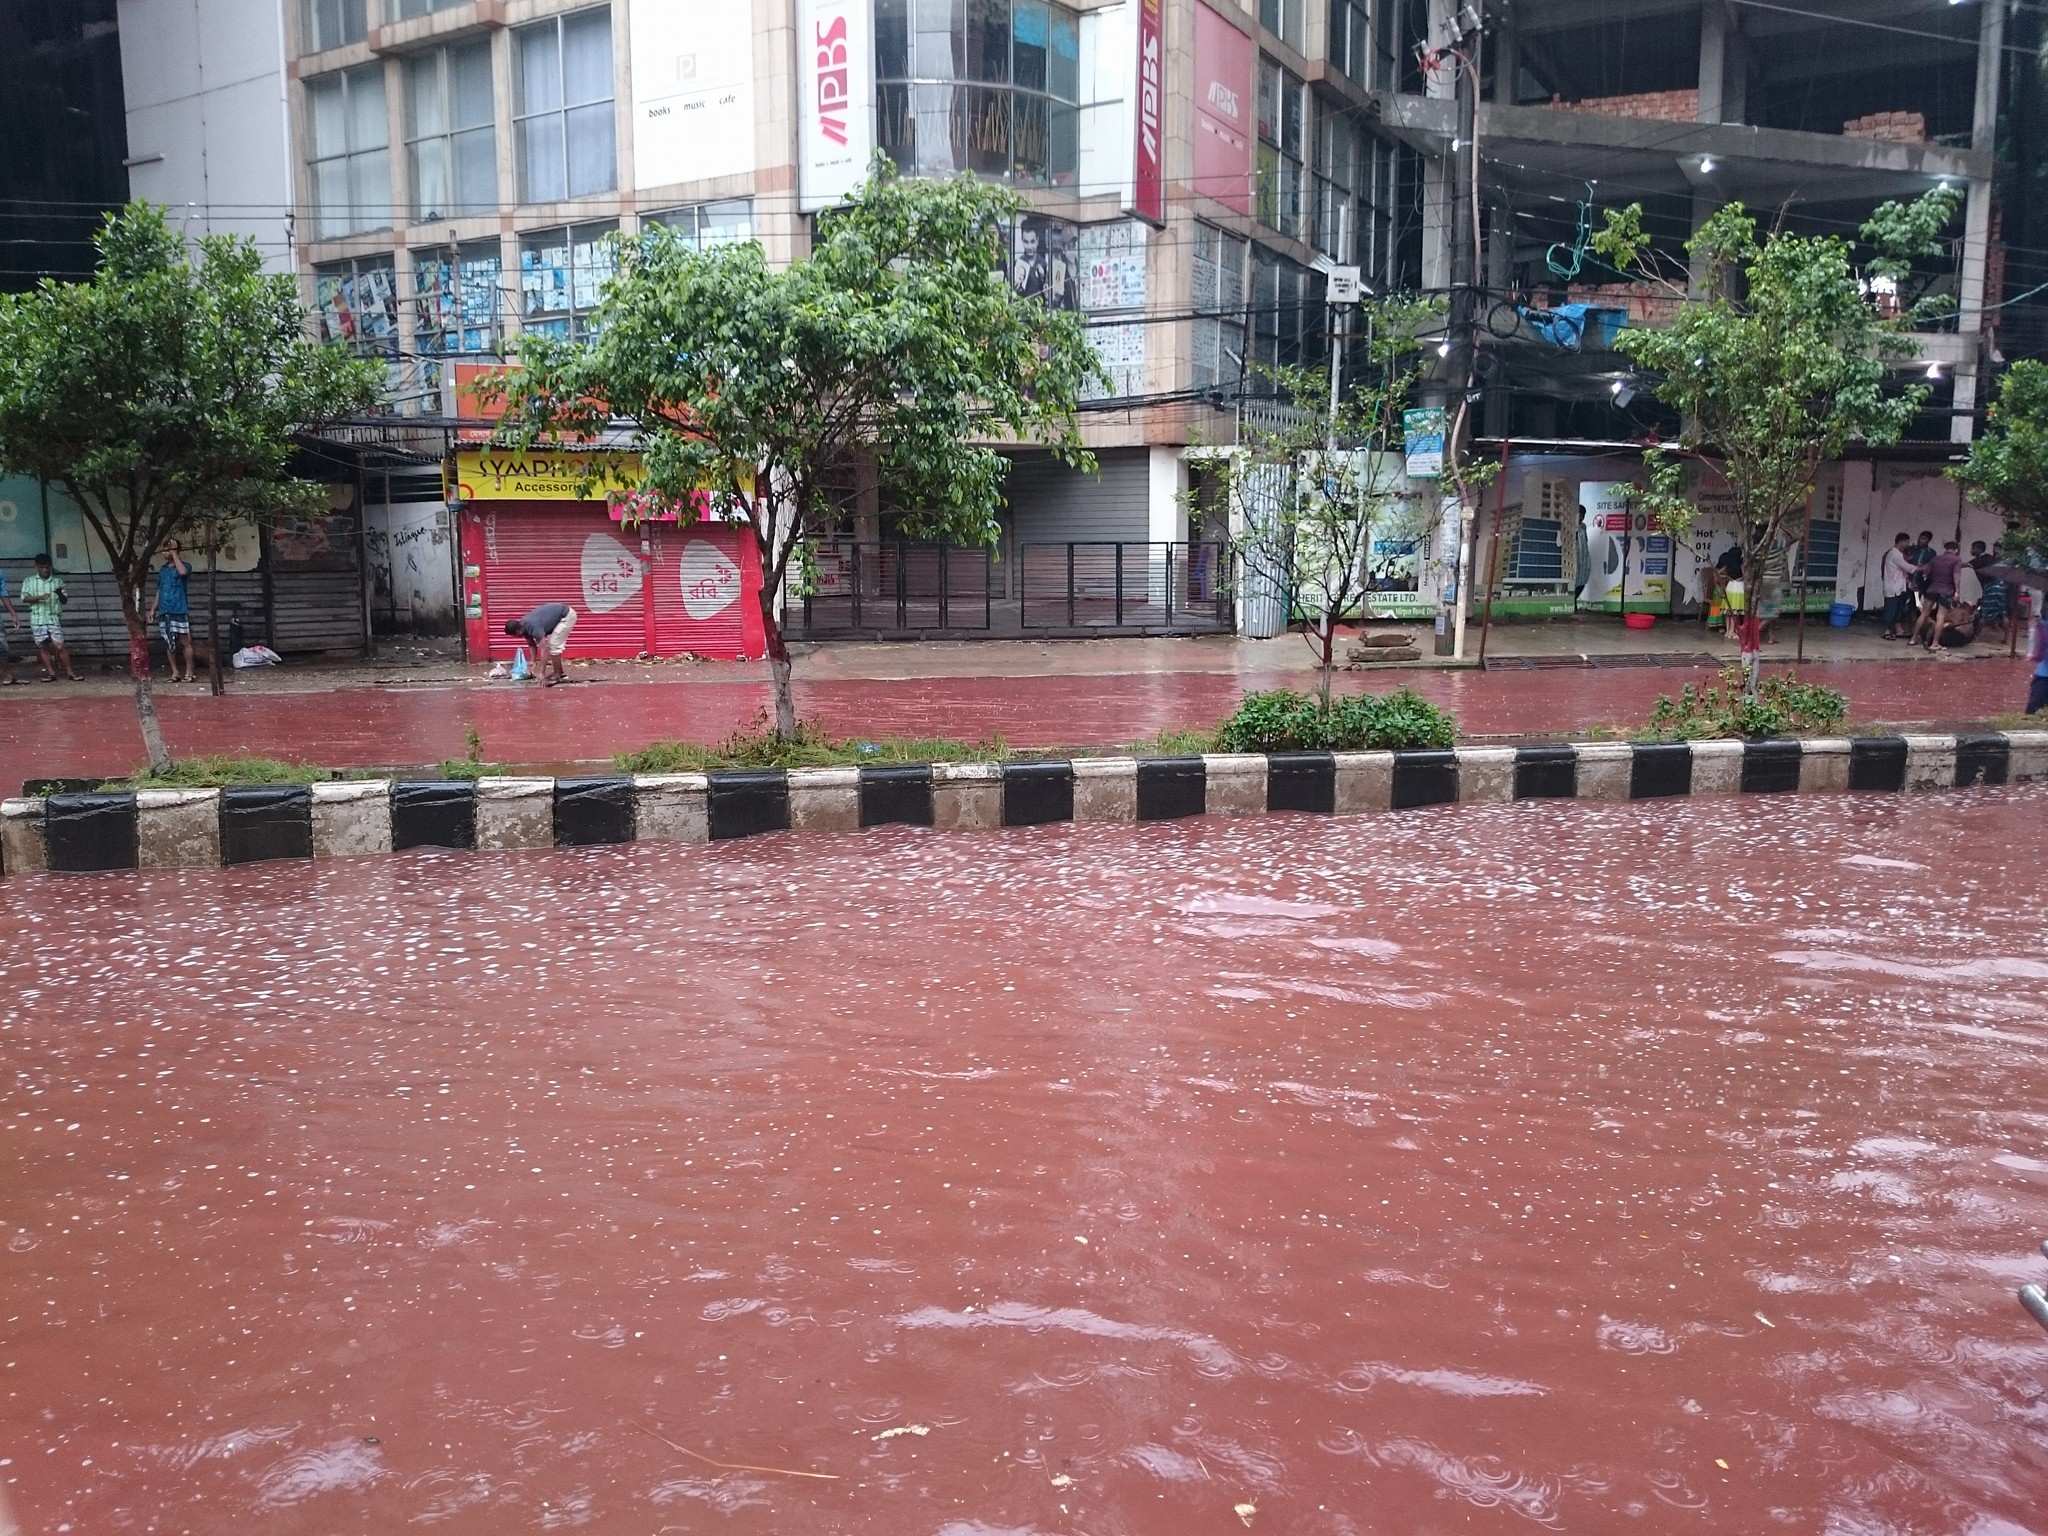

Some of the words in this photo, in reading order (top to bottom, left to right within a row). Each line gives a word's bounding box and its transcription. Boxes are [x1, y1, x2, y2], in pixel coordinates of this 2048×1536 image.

[648, 106, 671, 119] books
[683, 99, 705, 111] music
[514, 481, 578, 492] Accessor
[1367, 592, 1398, 603] ESTATE
